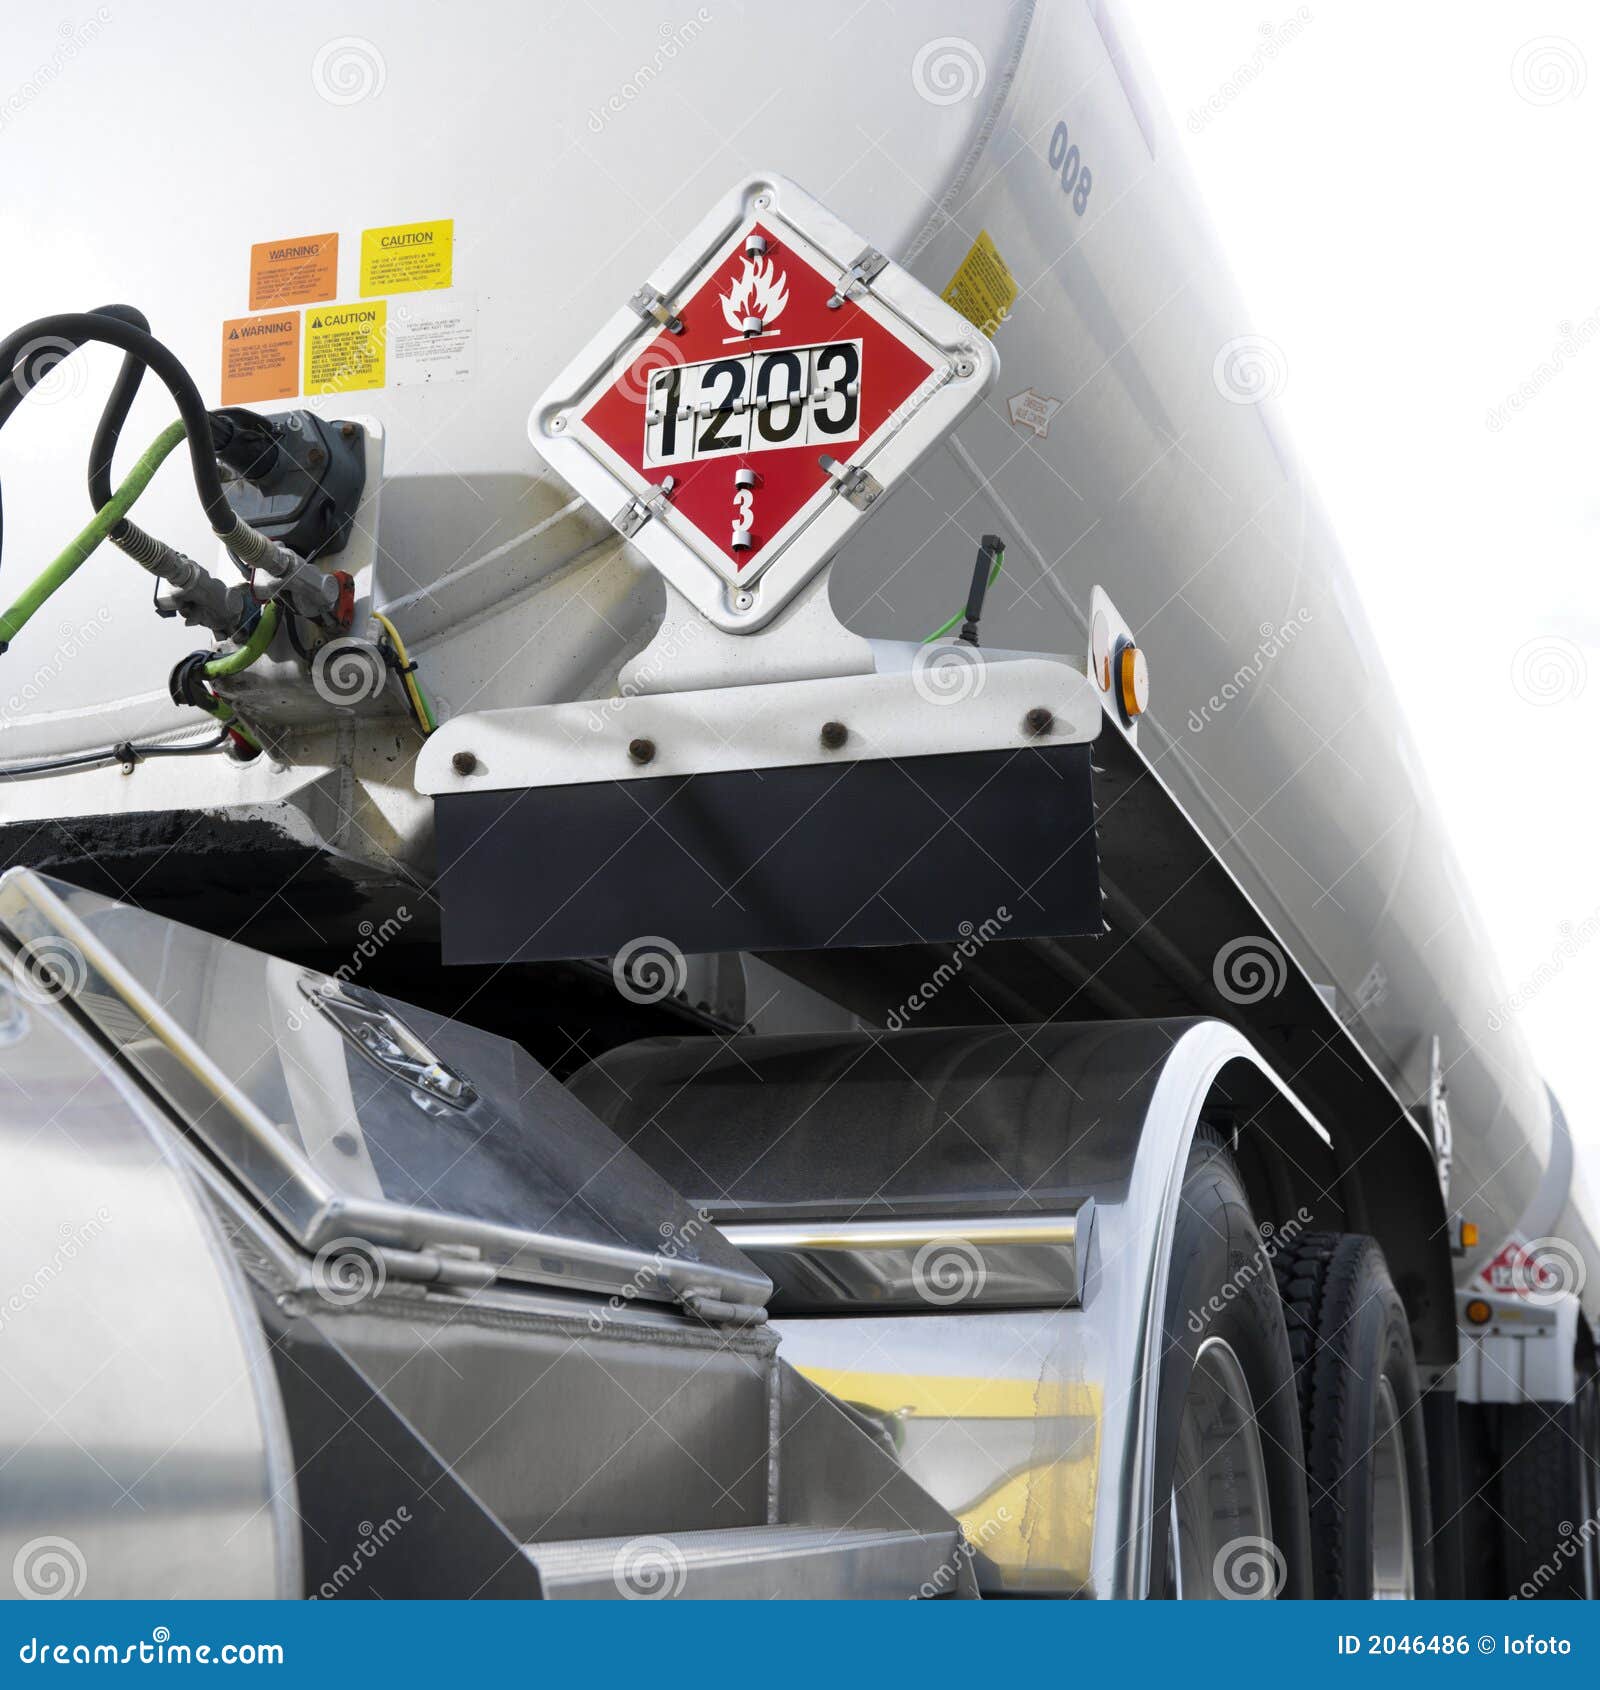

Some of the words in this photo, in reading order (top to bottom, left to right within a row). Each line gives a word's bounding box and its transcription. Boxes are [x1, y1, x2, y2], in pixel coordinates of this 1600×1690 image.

[1049, 121, 1092, 216] 008
[381, 232, 433, 247] CAUTION
[269, 245, 319, 260] WARNING
[324, 311, 376, 326] CAUTION
[241, 322, 292, 337] WARNING
[655, 344, 859, 457] 1203
[731, 489, 754, 532] 3
